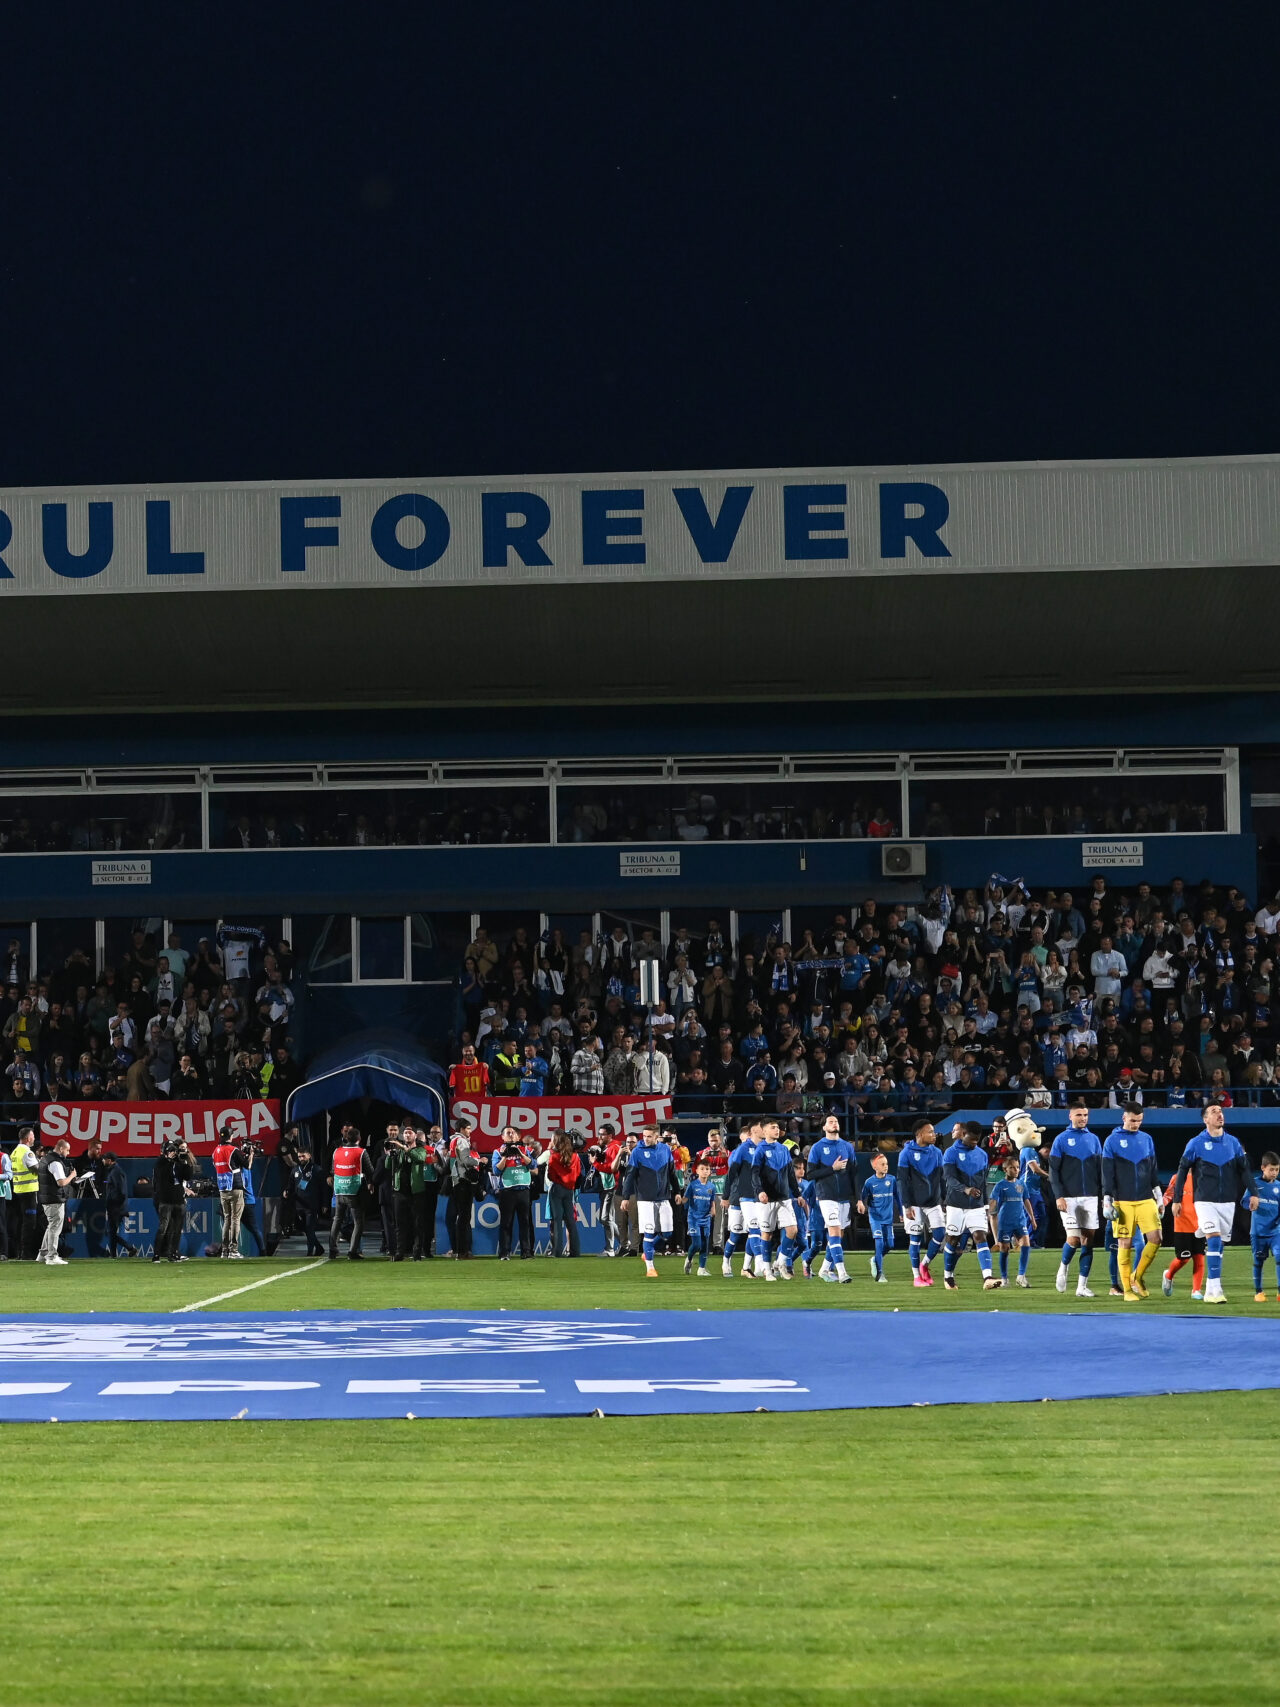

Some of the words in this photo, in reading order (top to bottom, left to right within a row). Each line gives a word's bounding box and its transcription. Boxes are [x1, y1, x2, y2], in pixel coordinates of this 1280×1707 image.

[280, 482, 952, 572] FOREVER
[625, 856, 665, 864] TRIBUNA
[464, 1076, 480, 1093] 10
[40, 1102, 280, 1144] SUPERLIGA
[450, 1098, 671, 1139] SUPERBET
